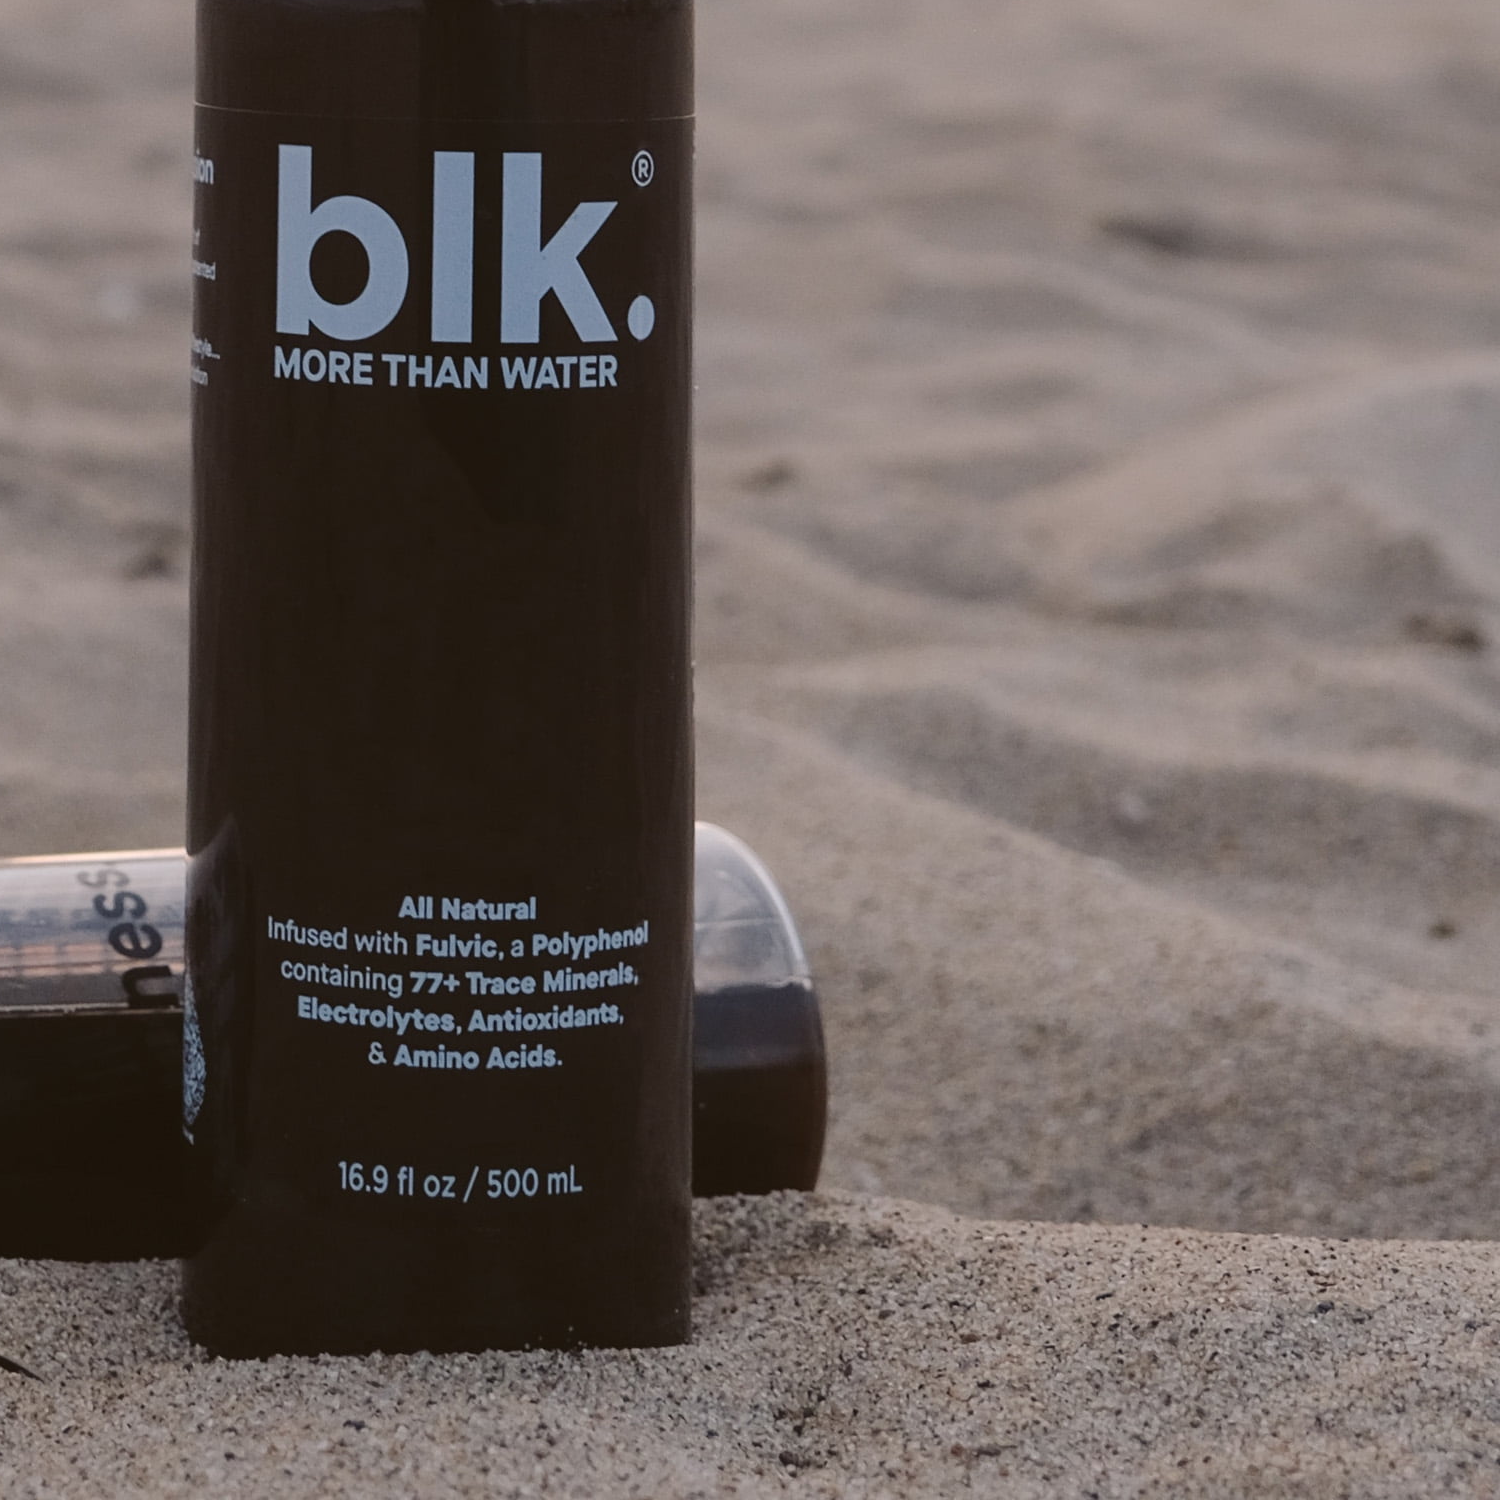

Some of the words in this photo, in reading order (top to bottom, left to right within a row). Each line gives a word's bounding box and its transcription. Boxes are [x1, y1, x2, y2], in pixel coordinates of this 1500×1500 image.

[276, 144, 655, 343] blk.
[275, 346, 373, 385] MORE
[382, 354, 488, 388] THAN
[501, 355, 617, 389] WATER
[399, 896, 433, 919] All
[442, 897, 536, 920] Natural
[269, 916, 347, 949] Infused
[355, 931, 407, 955] with
[417, 934, 504, 960] Fulvic,
[511, 940, 524, 957] a
[530, 920, 648, 960] Polyphenol
[281, 961, 402, 998] containing
[410, 972, 460, 993] 77+
[465, 972, 536, 994] Trace
[543, 962, 638, 992] Minerals,
[298, 996, 461, 1035] Electrolytes,
[468, 1003, 623, 1031] Antioxidants,
[369, 1042, 386, 1064] &
[394, 1044, 479, 1069] Amino
[487, 1044, 562, 1068] Acids.
[339, 1162, 388, 1193] 16.9
[398, 1166, 413, 1195] fl
[424, 1175, 455, 1197] oz
[464, 1167, 479, 1202] /
[488, 1168, 538, 1197] 500
[548, 1165, 582, 1194] mL
